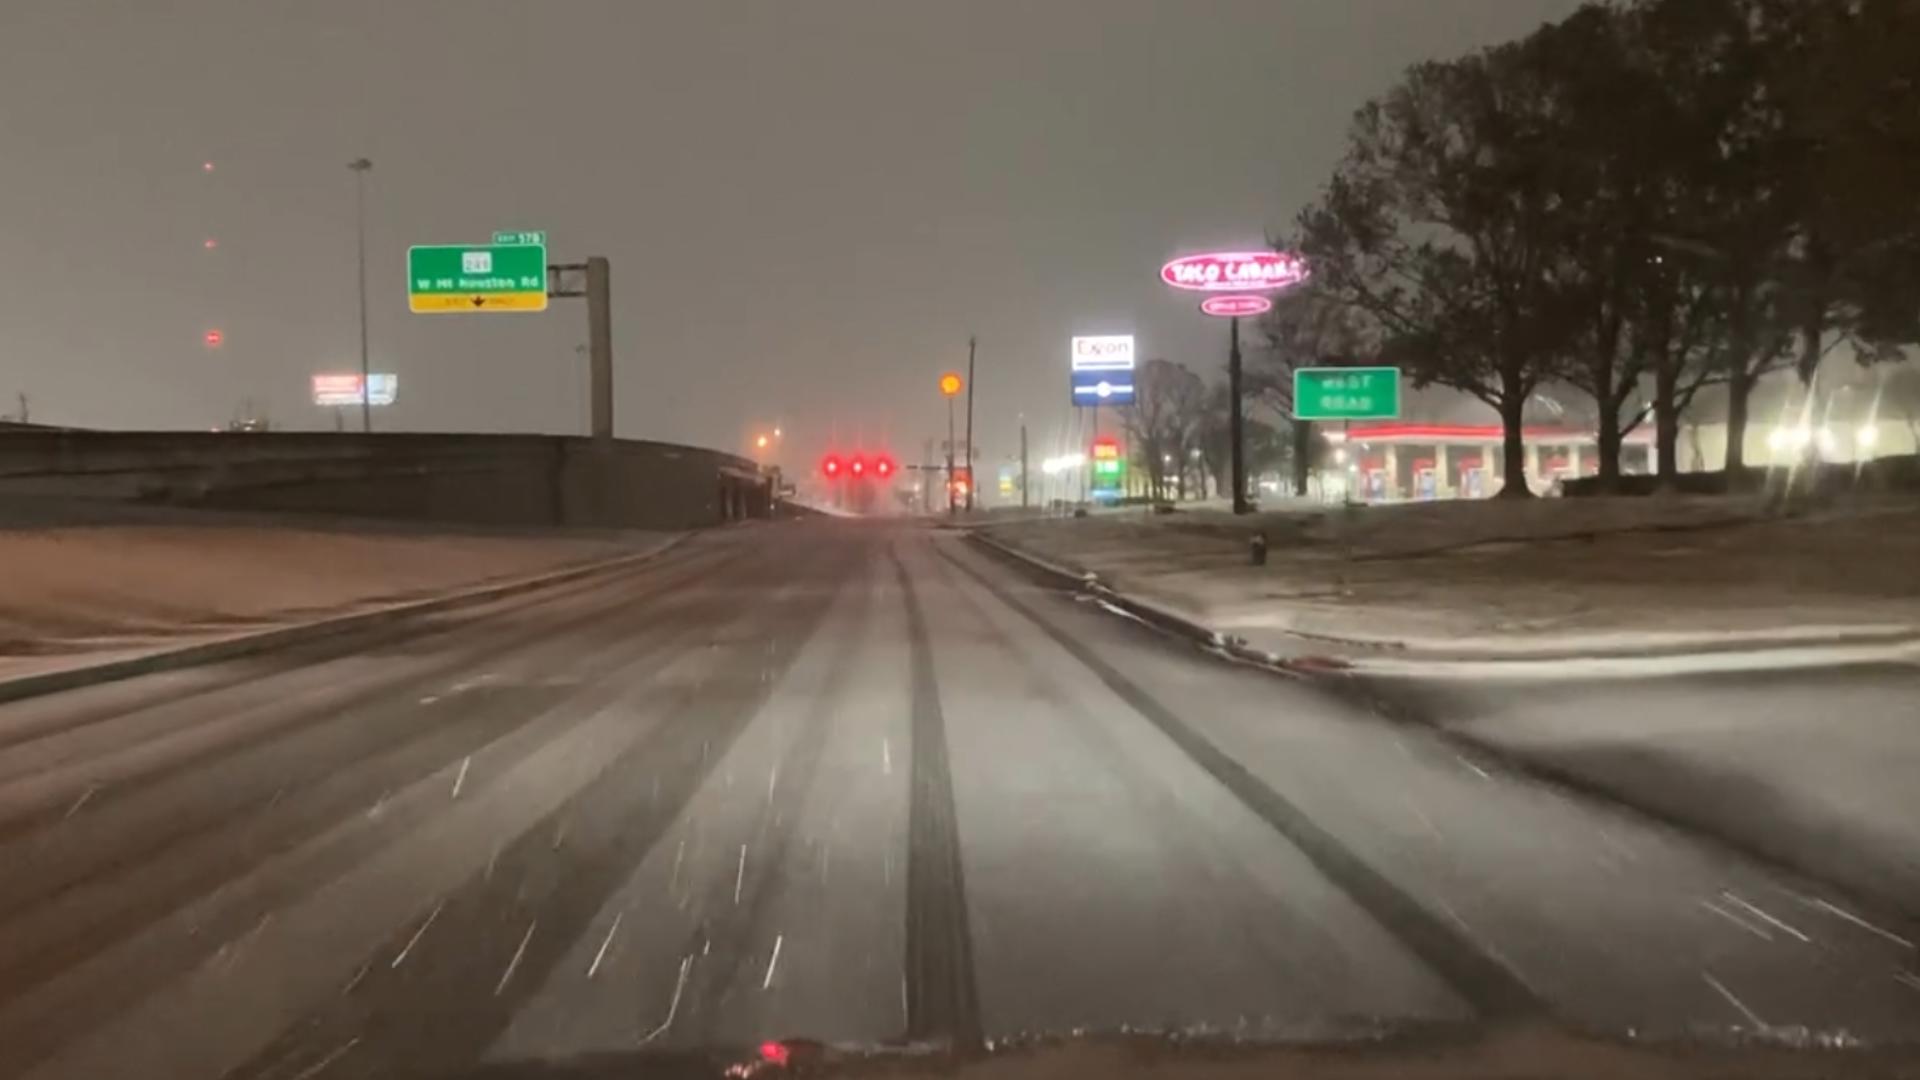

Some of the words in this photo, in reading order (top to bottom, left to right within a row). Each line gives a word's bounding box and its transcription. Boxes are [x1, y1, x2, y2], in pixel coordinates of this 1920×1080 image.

[1171, 263, 1220, 282] TACO
[417, 279, 431, 289] W
[459, 278, 515, 288] Houston
[521, 276, 539, 287] Rd
